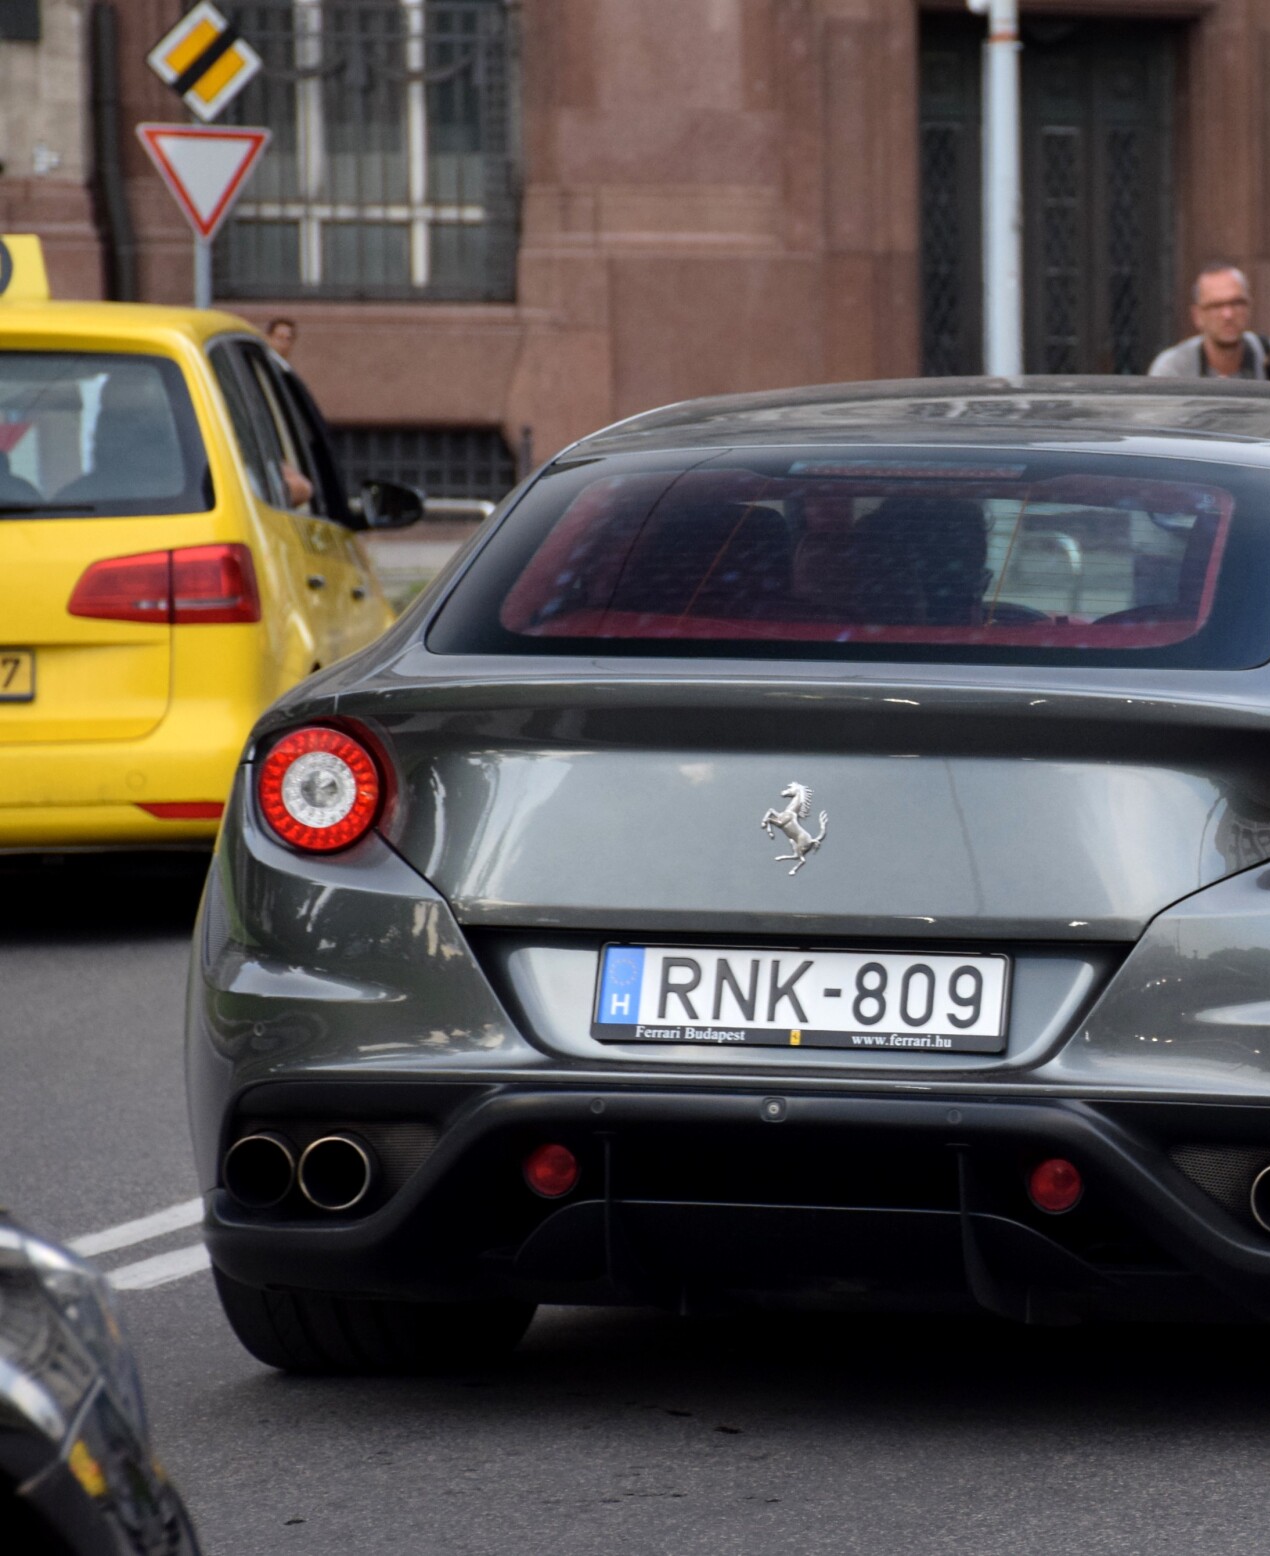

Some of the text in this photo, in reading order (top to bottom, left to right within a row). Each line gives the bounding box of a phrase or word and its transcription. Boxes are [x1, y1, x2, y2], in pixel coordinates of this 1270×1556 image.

[657, 956, 984, 1029] RNK-809
[610, 994, 629, 1016] H
[635, 1026, 745, 1044] Ferrari Budapest
[852, 1034, 952, 1049] www.ferrari.hu
